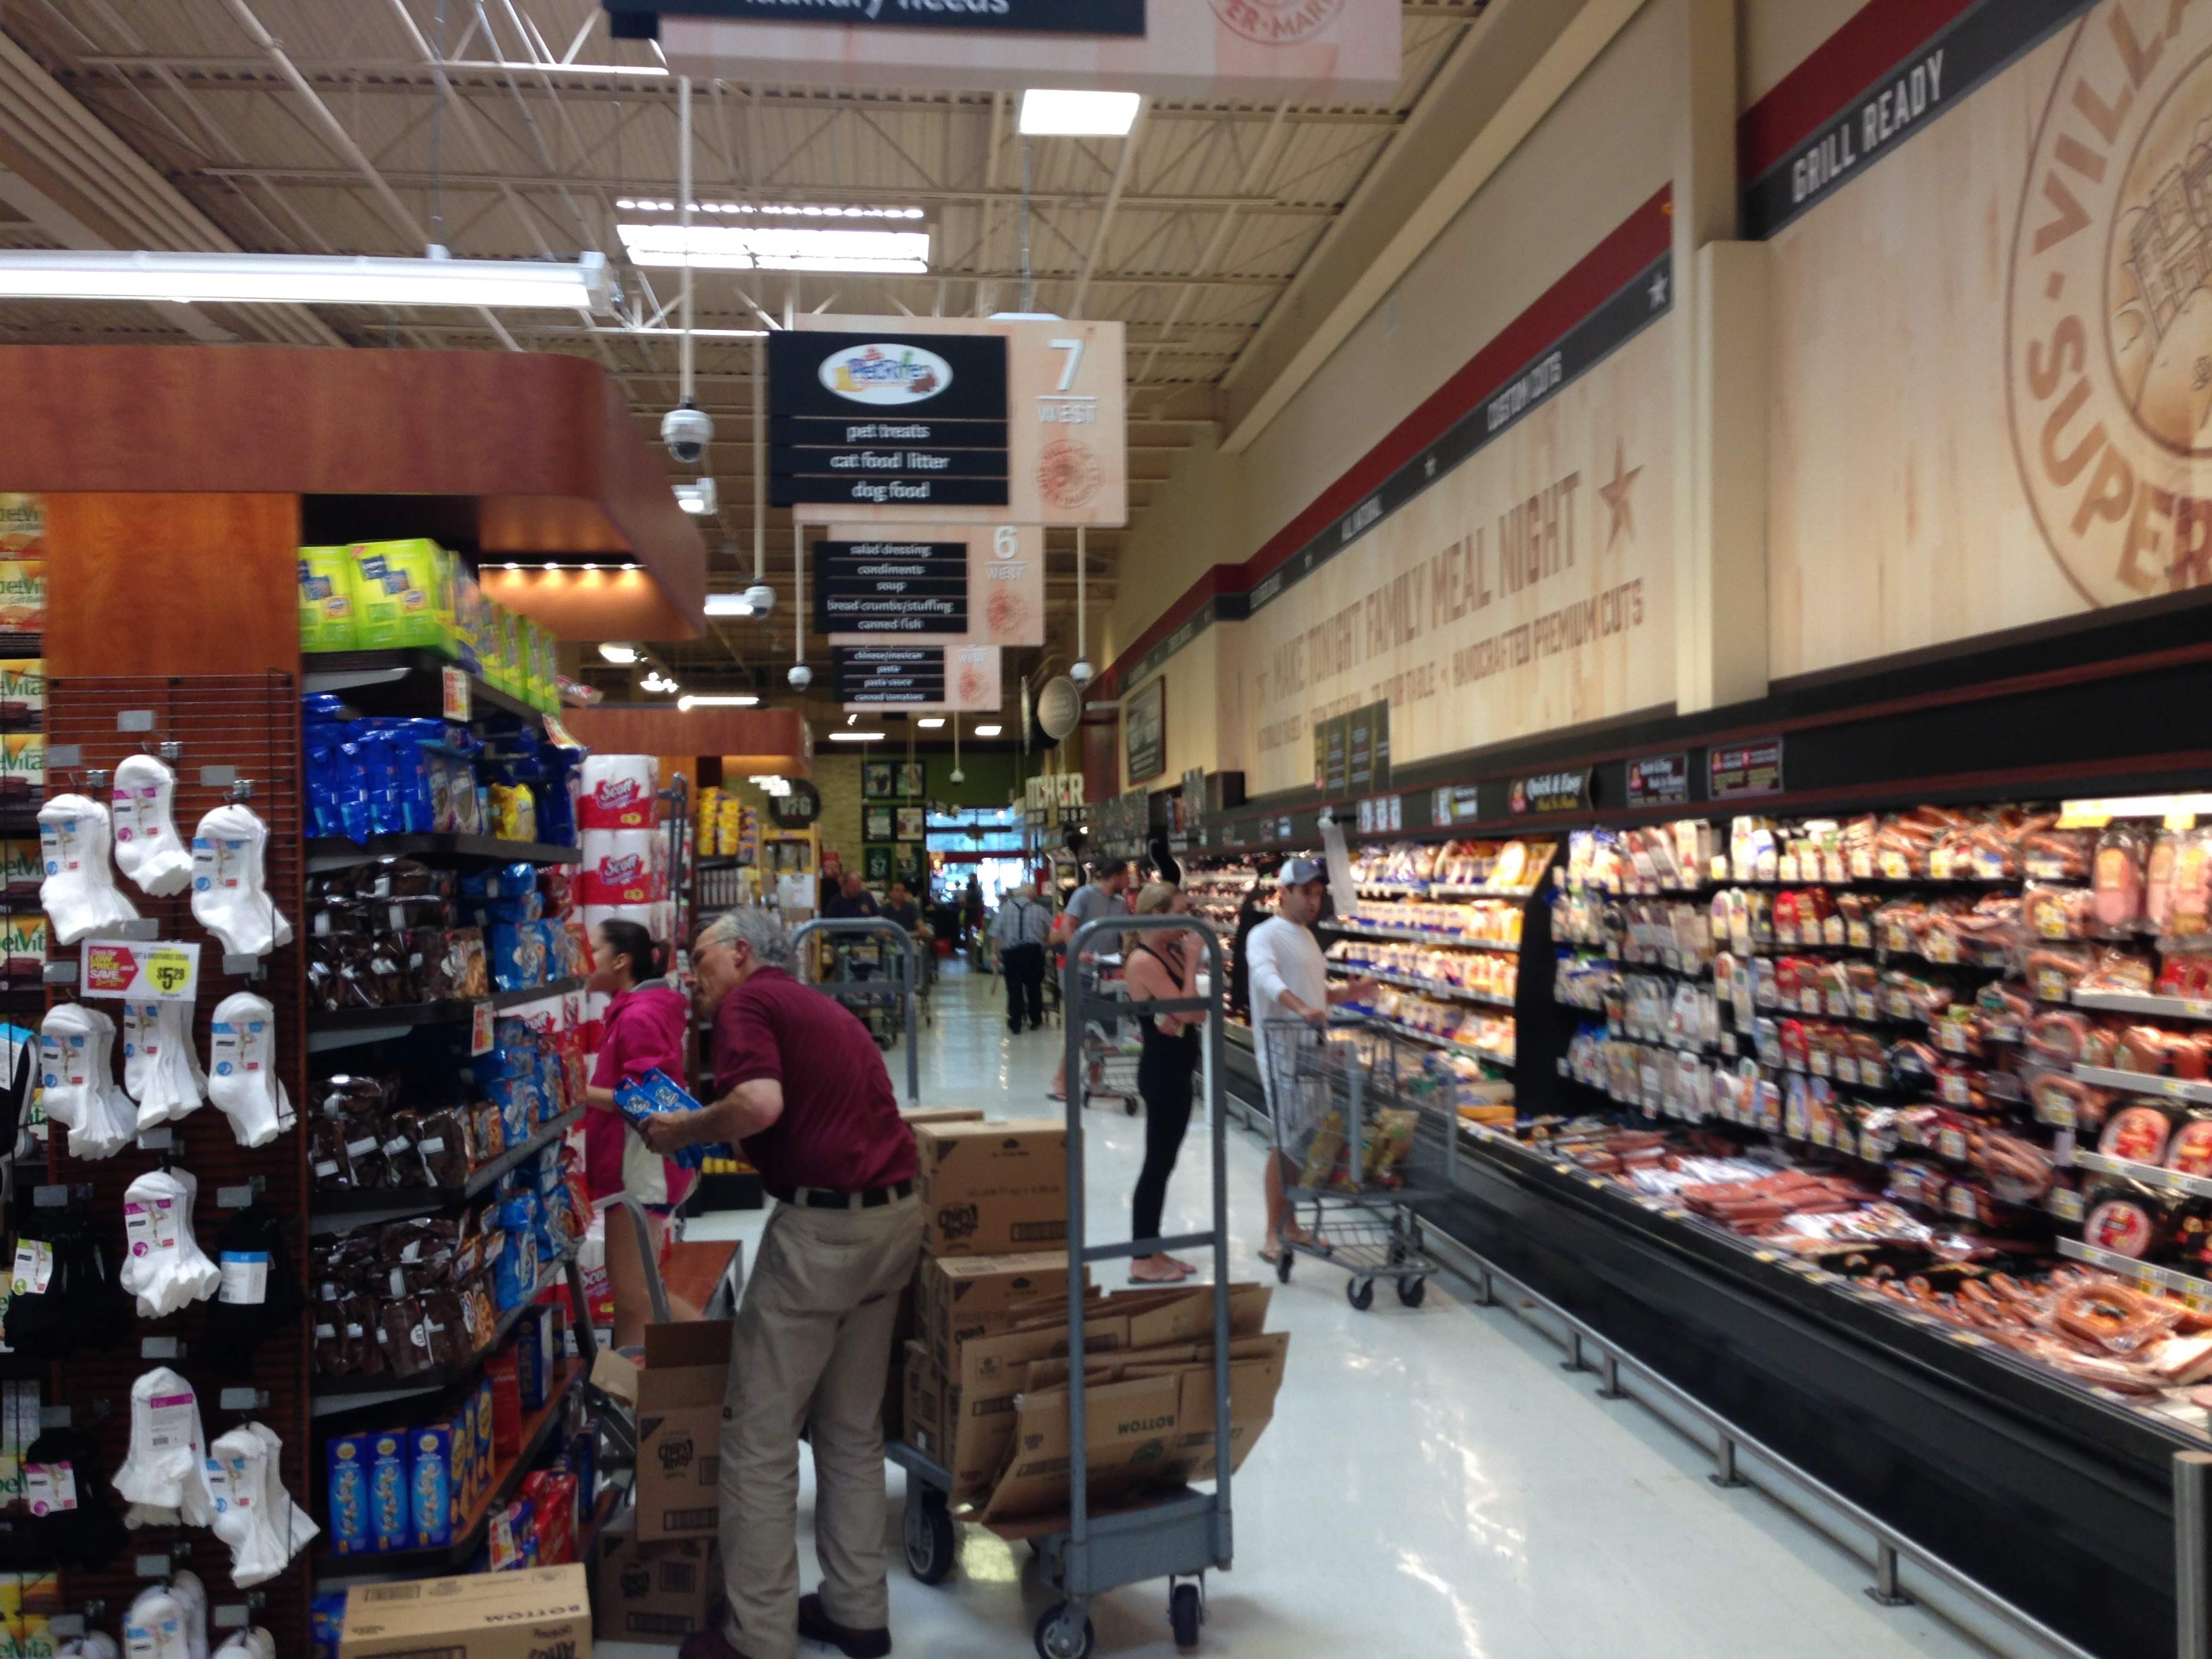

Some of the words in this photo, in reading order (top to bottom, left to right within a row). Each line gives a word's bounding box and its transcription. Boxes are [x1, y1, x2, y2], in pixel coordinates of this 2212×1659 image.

[1791, 123, 1857, 203] GRILL
[1862, 48, 1944, 153] READY
[1048, 339, 1084, 391] 7
[1039, 405, 1097, 424] WEST
[846, 424, 876, 442] pet
[878, 424, 931, 438] treats
[830, 455, 859, 468] cat
[861, 451, 903, 468] food
[907, 452, 951, 469] litter
[851, 480, 888, 502] dog
[889, 480, 931, 498] food
[850, 544, 880, 556] salad
[882, 544, 933, 558] dressing
[993, 527, 1020, 559] 6
[1430, 526, 1492, 631] MEAL
[1498, 470, 1581, 599] NIGHT
[857, 562, 926, 575] condiments
[987, 567, 1025, 580] WEST
[876, 581, 907, 593] soup
[827, 599, 859, 611] bread
[1599, 576, 1645, 636] CUTS
[858, 618, 898, 630] canned
[899, 617, 924, 630] fish
[1118, 1414, 1176, 1434] BOTTOM
